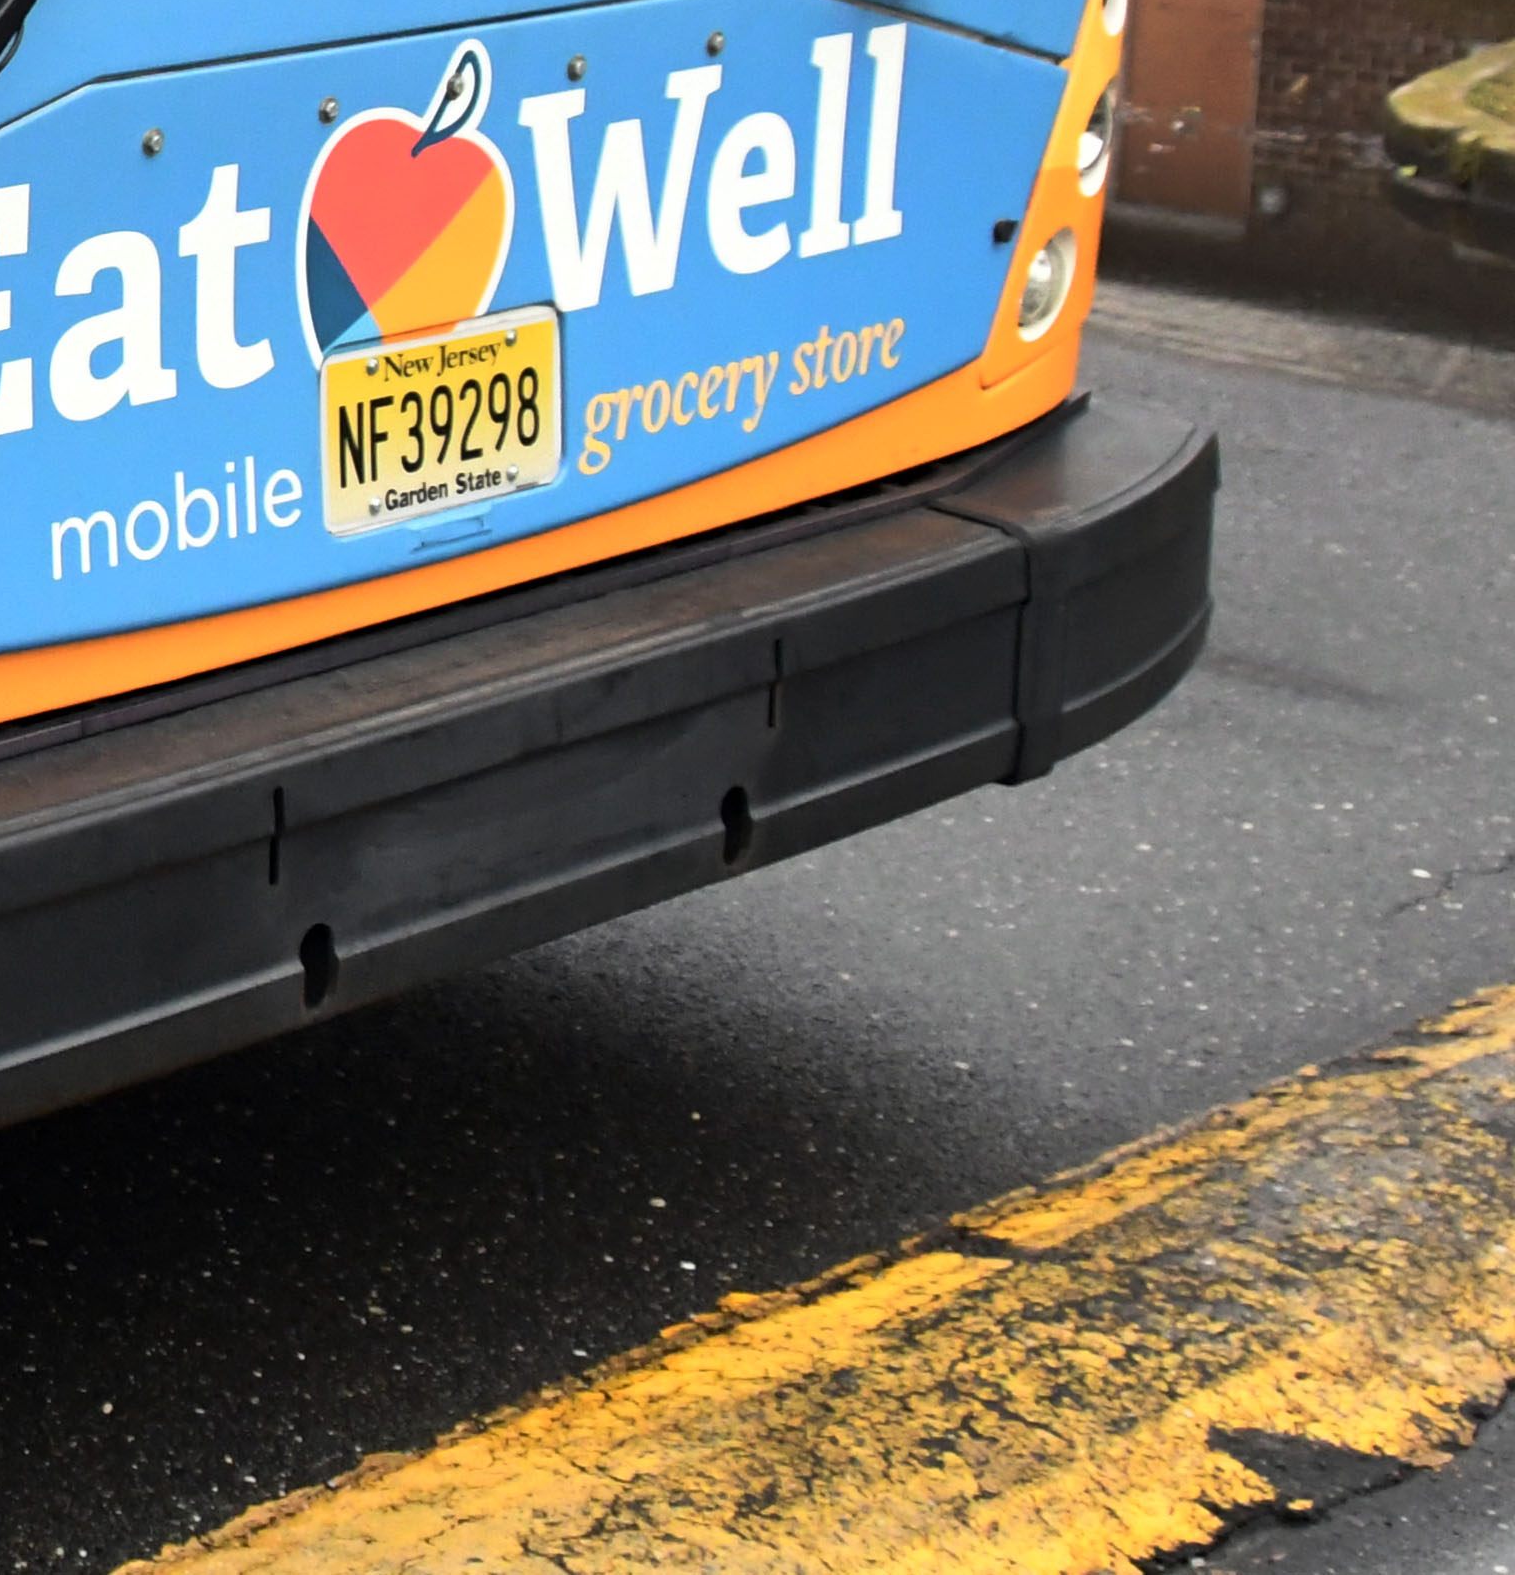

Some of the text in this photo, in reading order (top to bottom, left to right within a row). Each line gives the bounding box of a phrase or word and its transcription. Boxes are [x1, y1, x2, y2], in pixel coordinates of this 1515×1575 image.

[518, 23, 907, 312] Well
[383, 343, 501, 382] New Jersey
[51, 316, 906, 580] mobile grocery store
[338, 367, 540, 489] NF39298
[384, 470, 502, 511] Garden State
